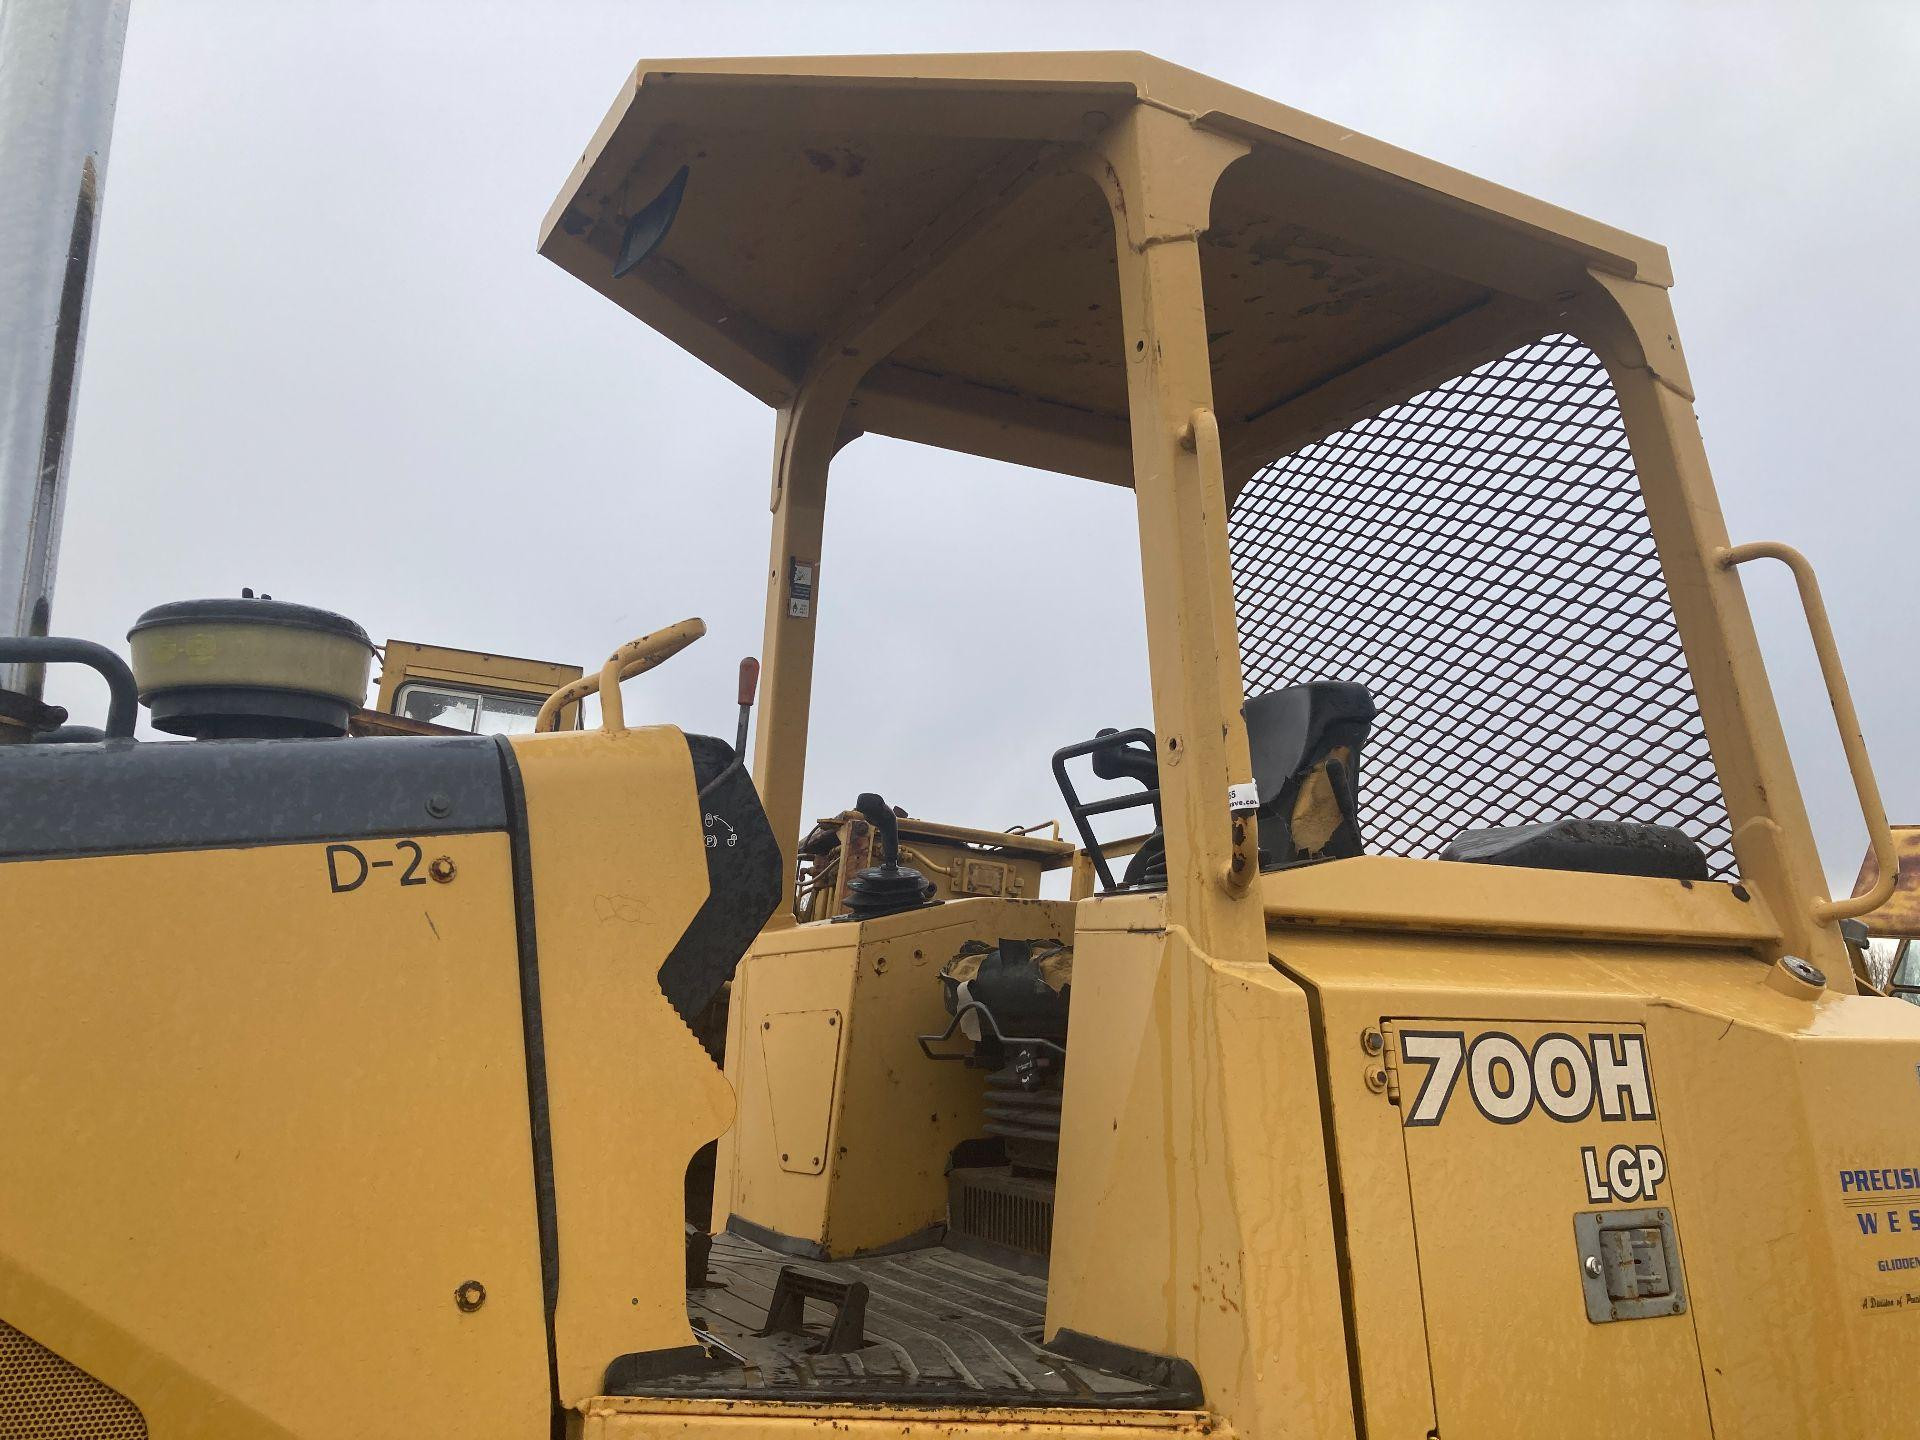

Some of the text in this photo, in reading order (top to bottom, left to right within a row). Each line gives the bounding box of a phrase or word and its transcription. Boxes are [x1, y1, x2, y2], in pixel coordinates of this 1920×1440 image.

[326, 840, 426, 893] D-2
[1399, 1029, 1657, 1127] 700H
[1580, 1144, 1666, 1204] LGP
